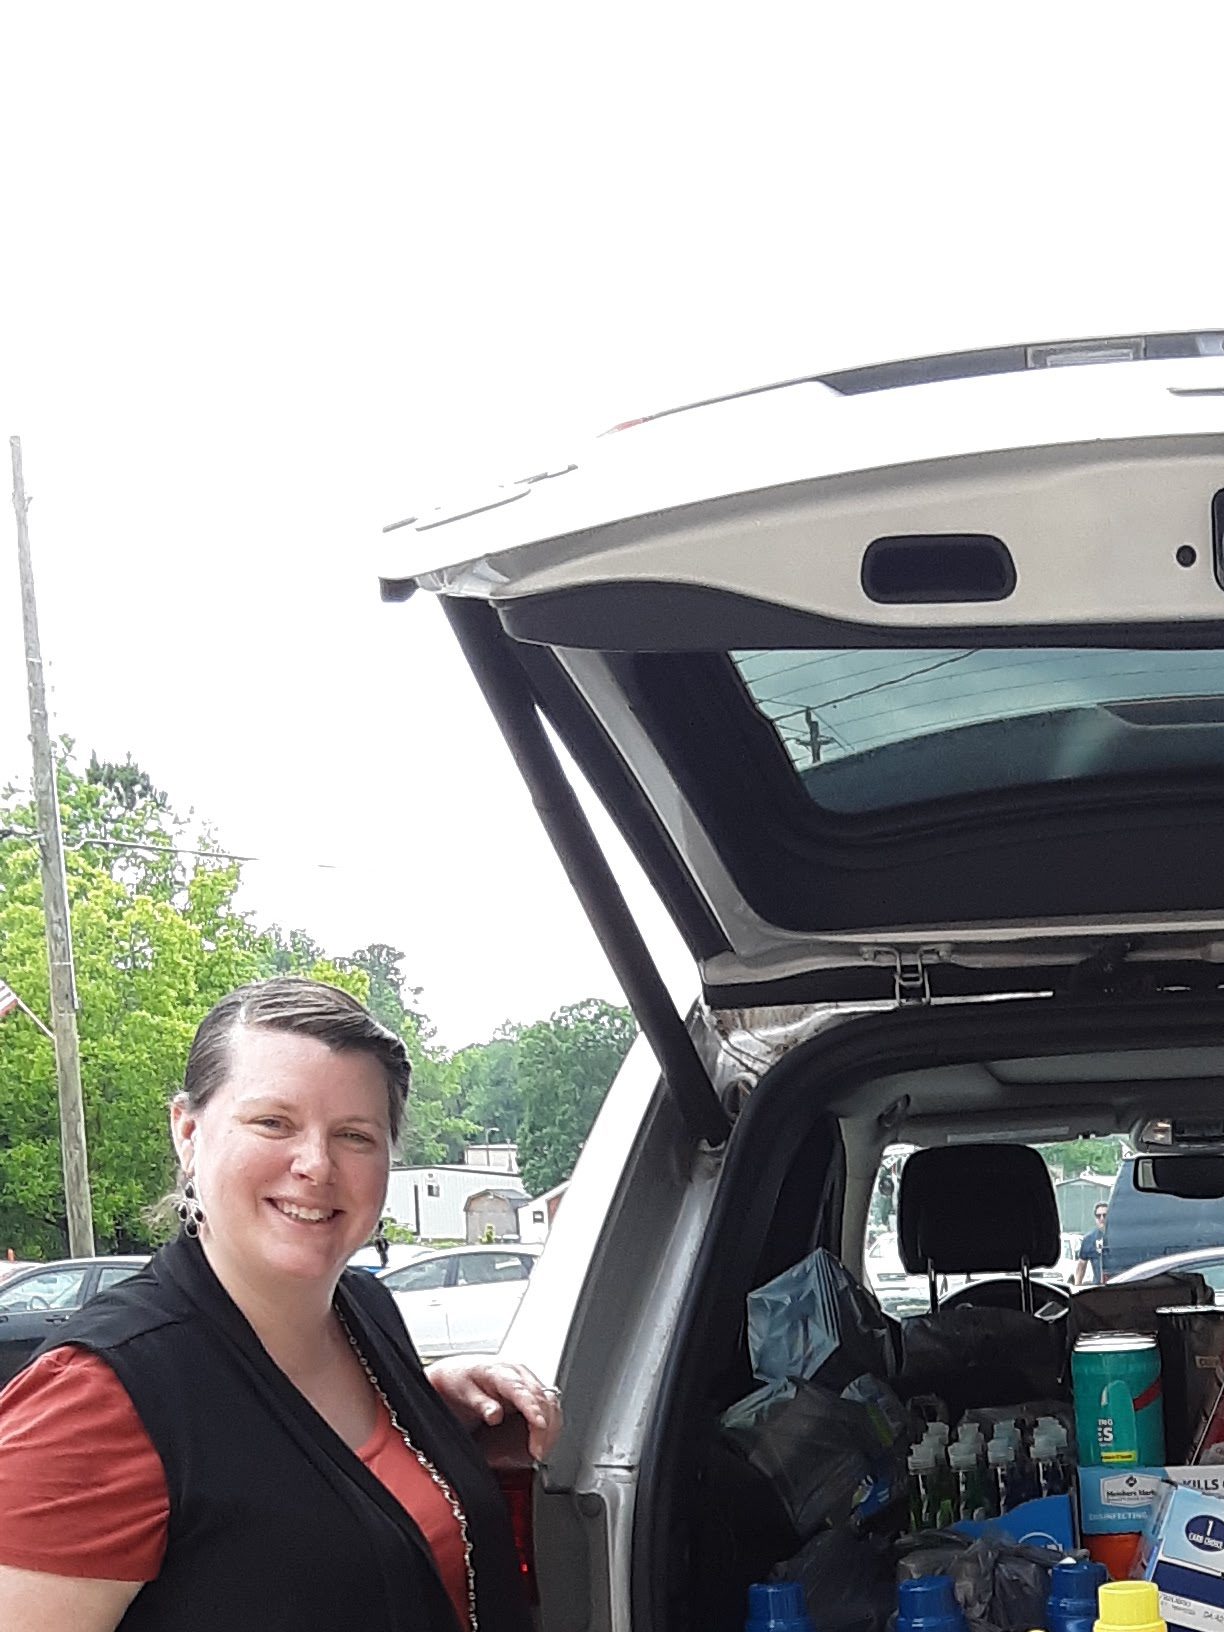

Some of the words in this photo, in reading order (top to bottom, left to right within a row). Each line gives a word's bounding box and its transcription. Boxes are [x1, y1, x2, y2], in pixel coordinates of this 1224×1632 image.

[1206, 1520, 1214, 1536] 1
[1188, 1533, 1204, 1544] CARB
[1204, 1537, 1224, 1550] CHOICE
